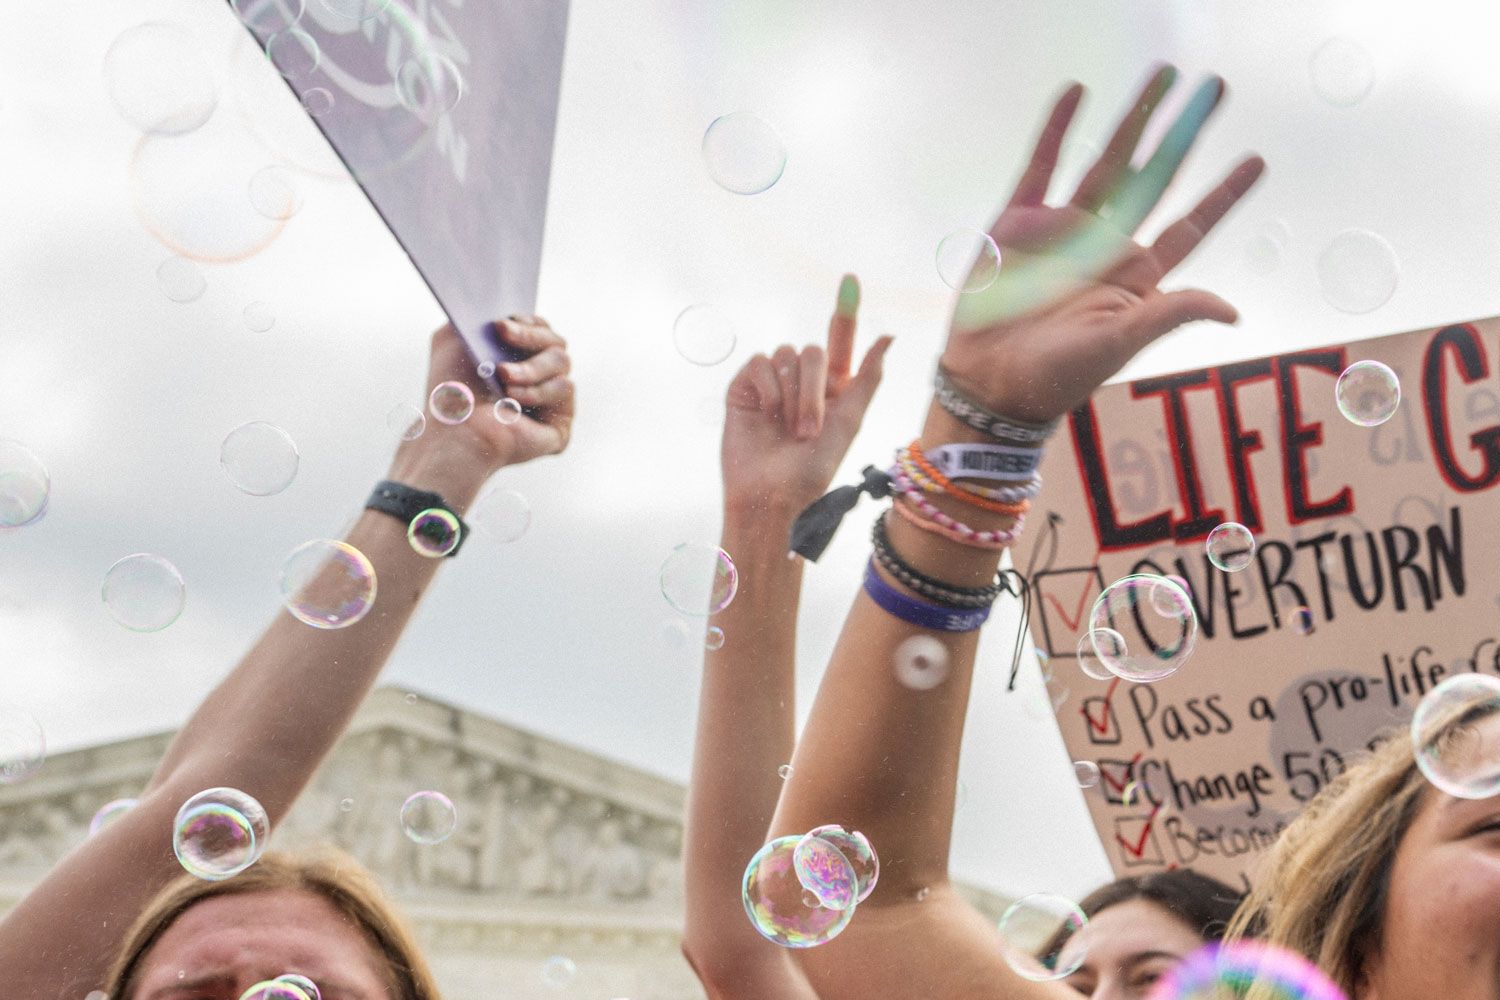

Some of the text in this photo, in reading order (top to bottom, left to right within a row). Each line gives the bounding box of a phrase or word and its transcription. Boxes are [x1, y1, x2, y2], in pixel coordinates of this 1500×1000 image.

[1068, 347, 1355, 553] LIFE
[1129, 505, 1466, 660] OVERTURN
[1129, 682, 1233, 748] Pass
[1250, 695, 1276, 722] a
[1301, 644, 1446, 742] pro-life
[1141, 758, 1273, 817] Change
[1164, 815, 1282, 865] Becom
